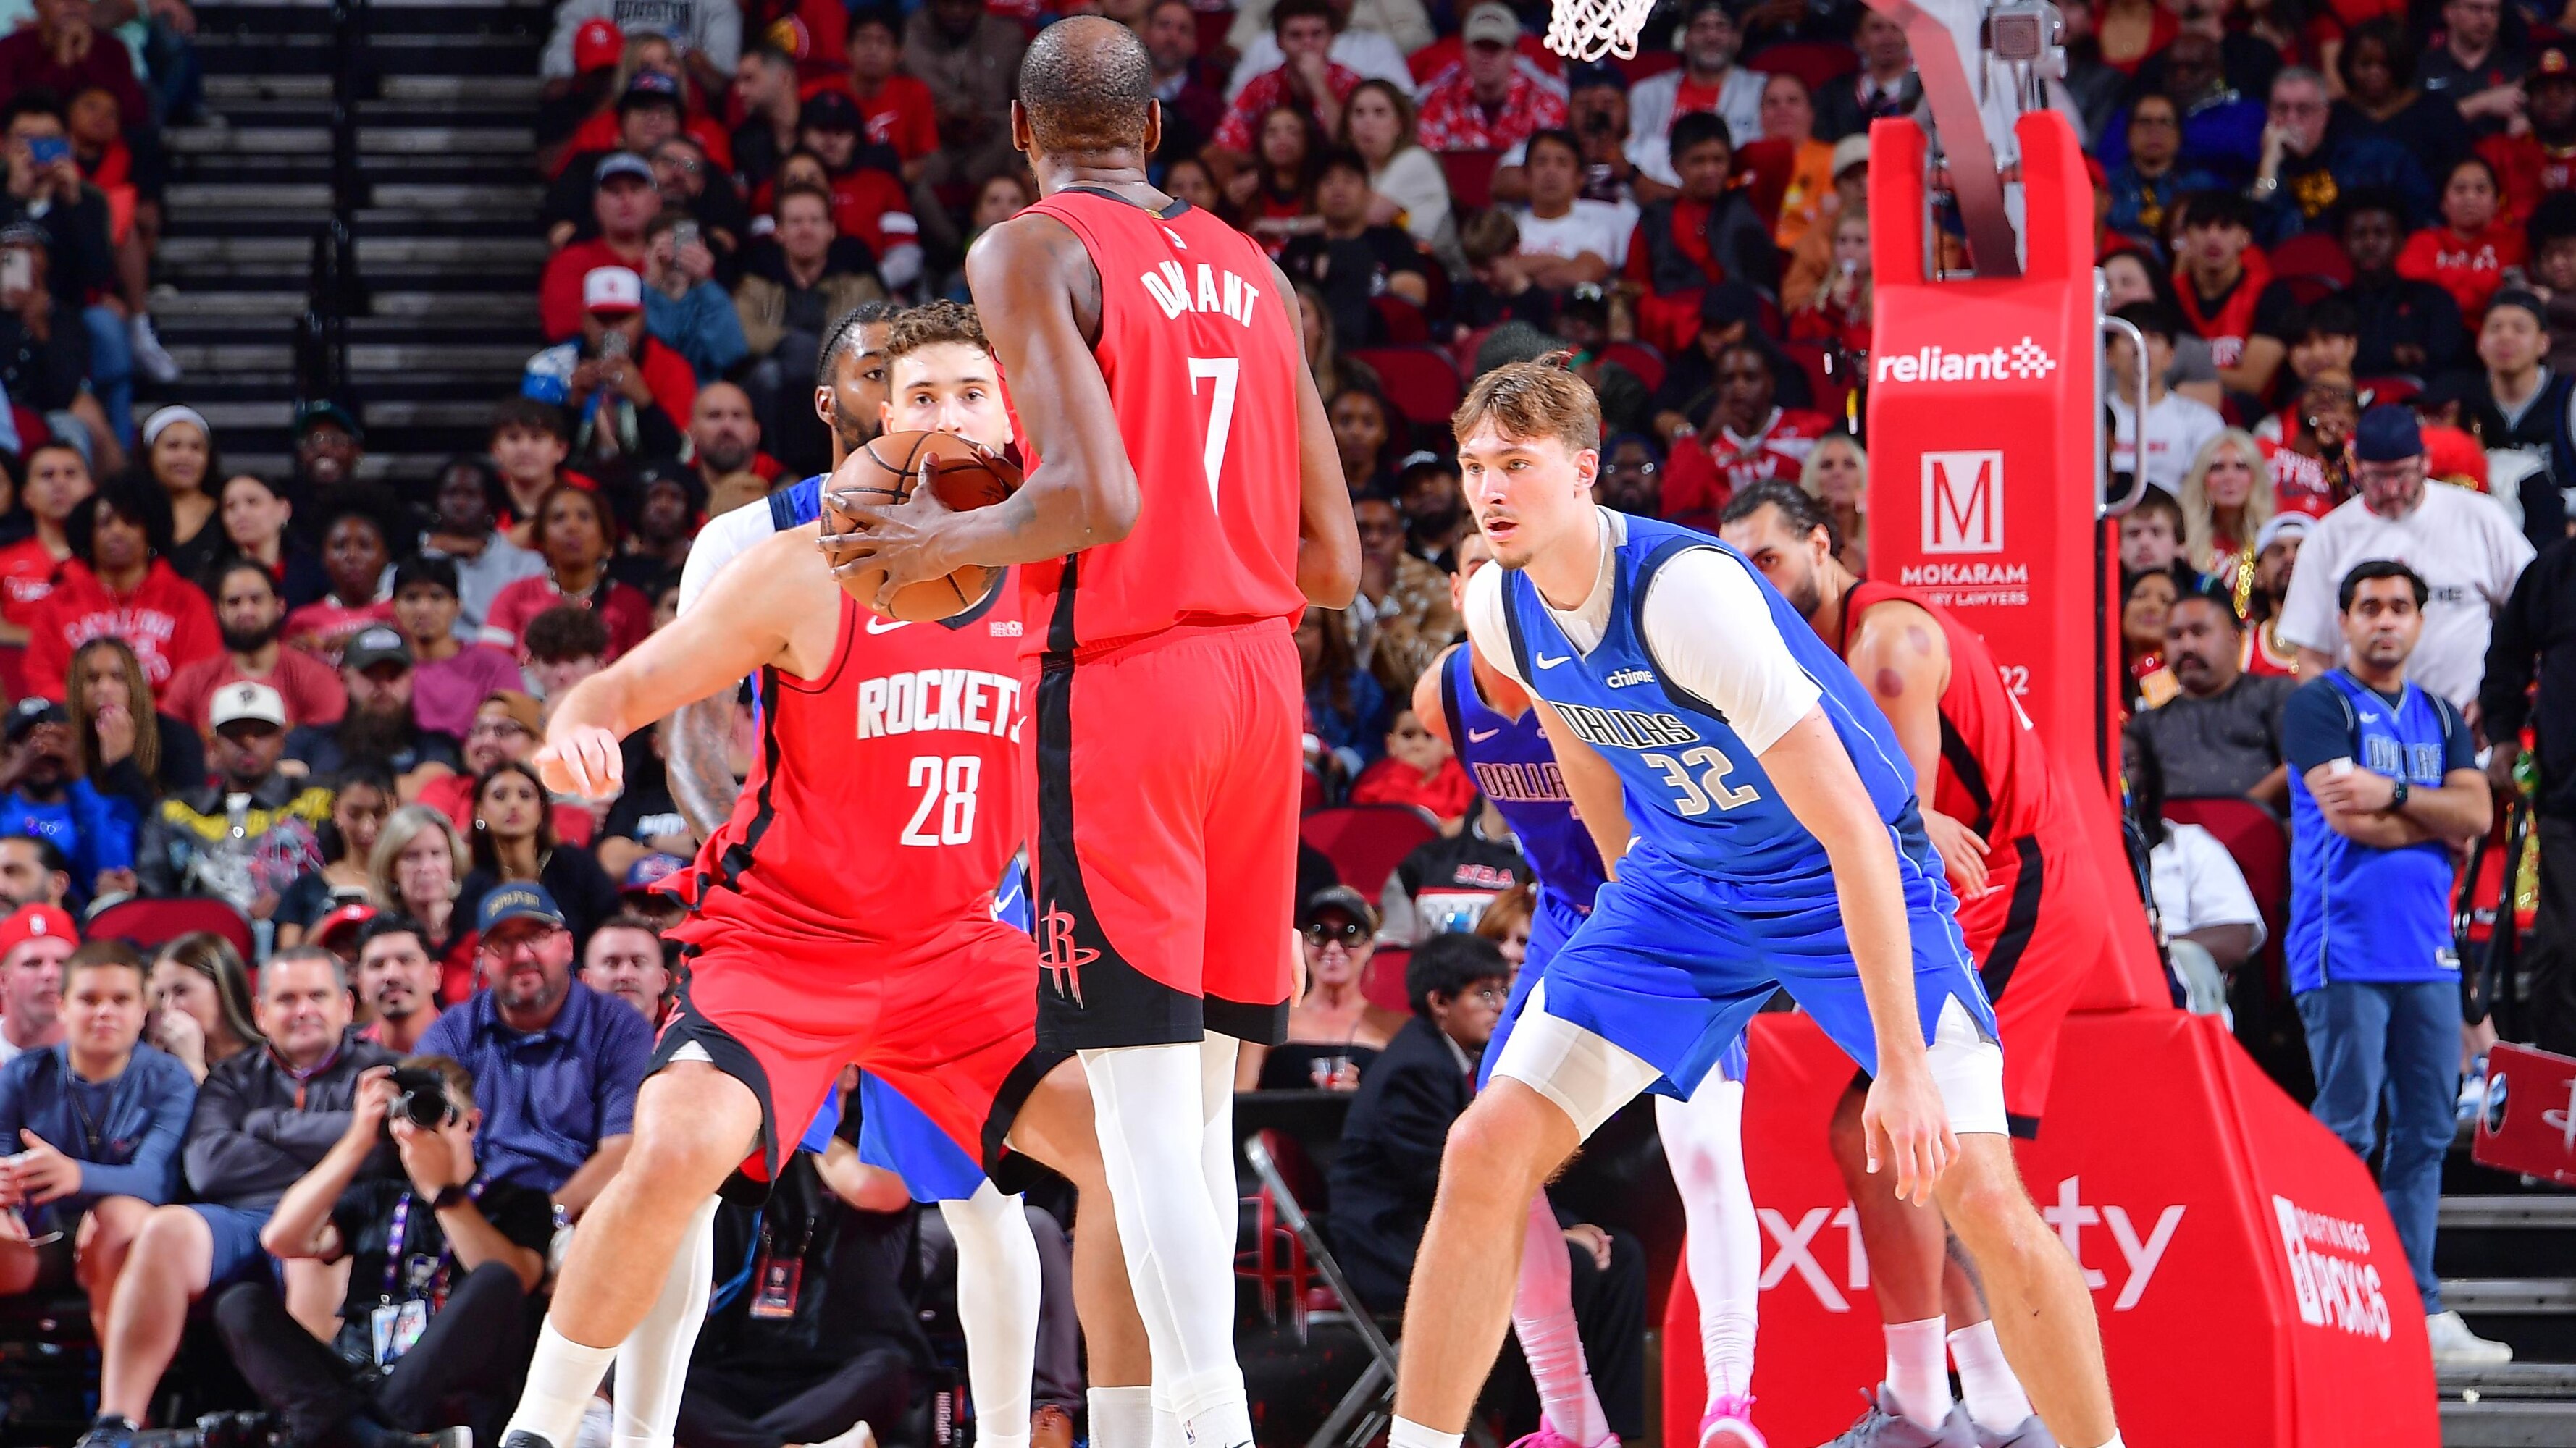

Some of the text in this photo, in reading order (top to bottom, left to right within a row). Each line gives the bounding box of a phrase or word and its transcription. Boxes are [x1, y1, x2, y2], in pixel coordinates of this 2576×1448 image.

[1877, 345, 2010, 382] reliant
[1187, 356, 1240, 517] 7
[1932, 460, 1991, 544] M
[1900, 563, 2028, 586] MOKARAM
[1955, 591, 2028, 606] LAWYERS
[1606, 669, 1655, 689] chime
[1549, 700, 1700, 749] DALLAS
[900, 755, 981, 846] 28
[1472, 762, 1573, 802] DALLA
[1640, 746, 1761, 816] 32
[1453, 864, 1515, 889] NBA
[935, 1392, 951, 1445] POPCORN
